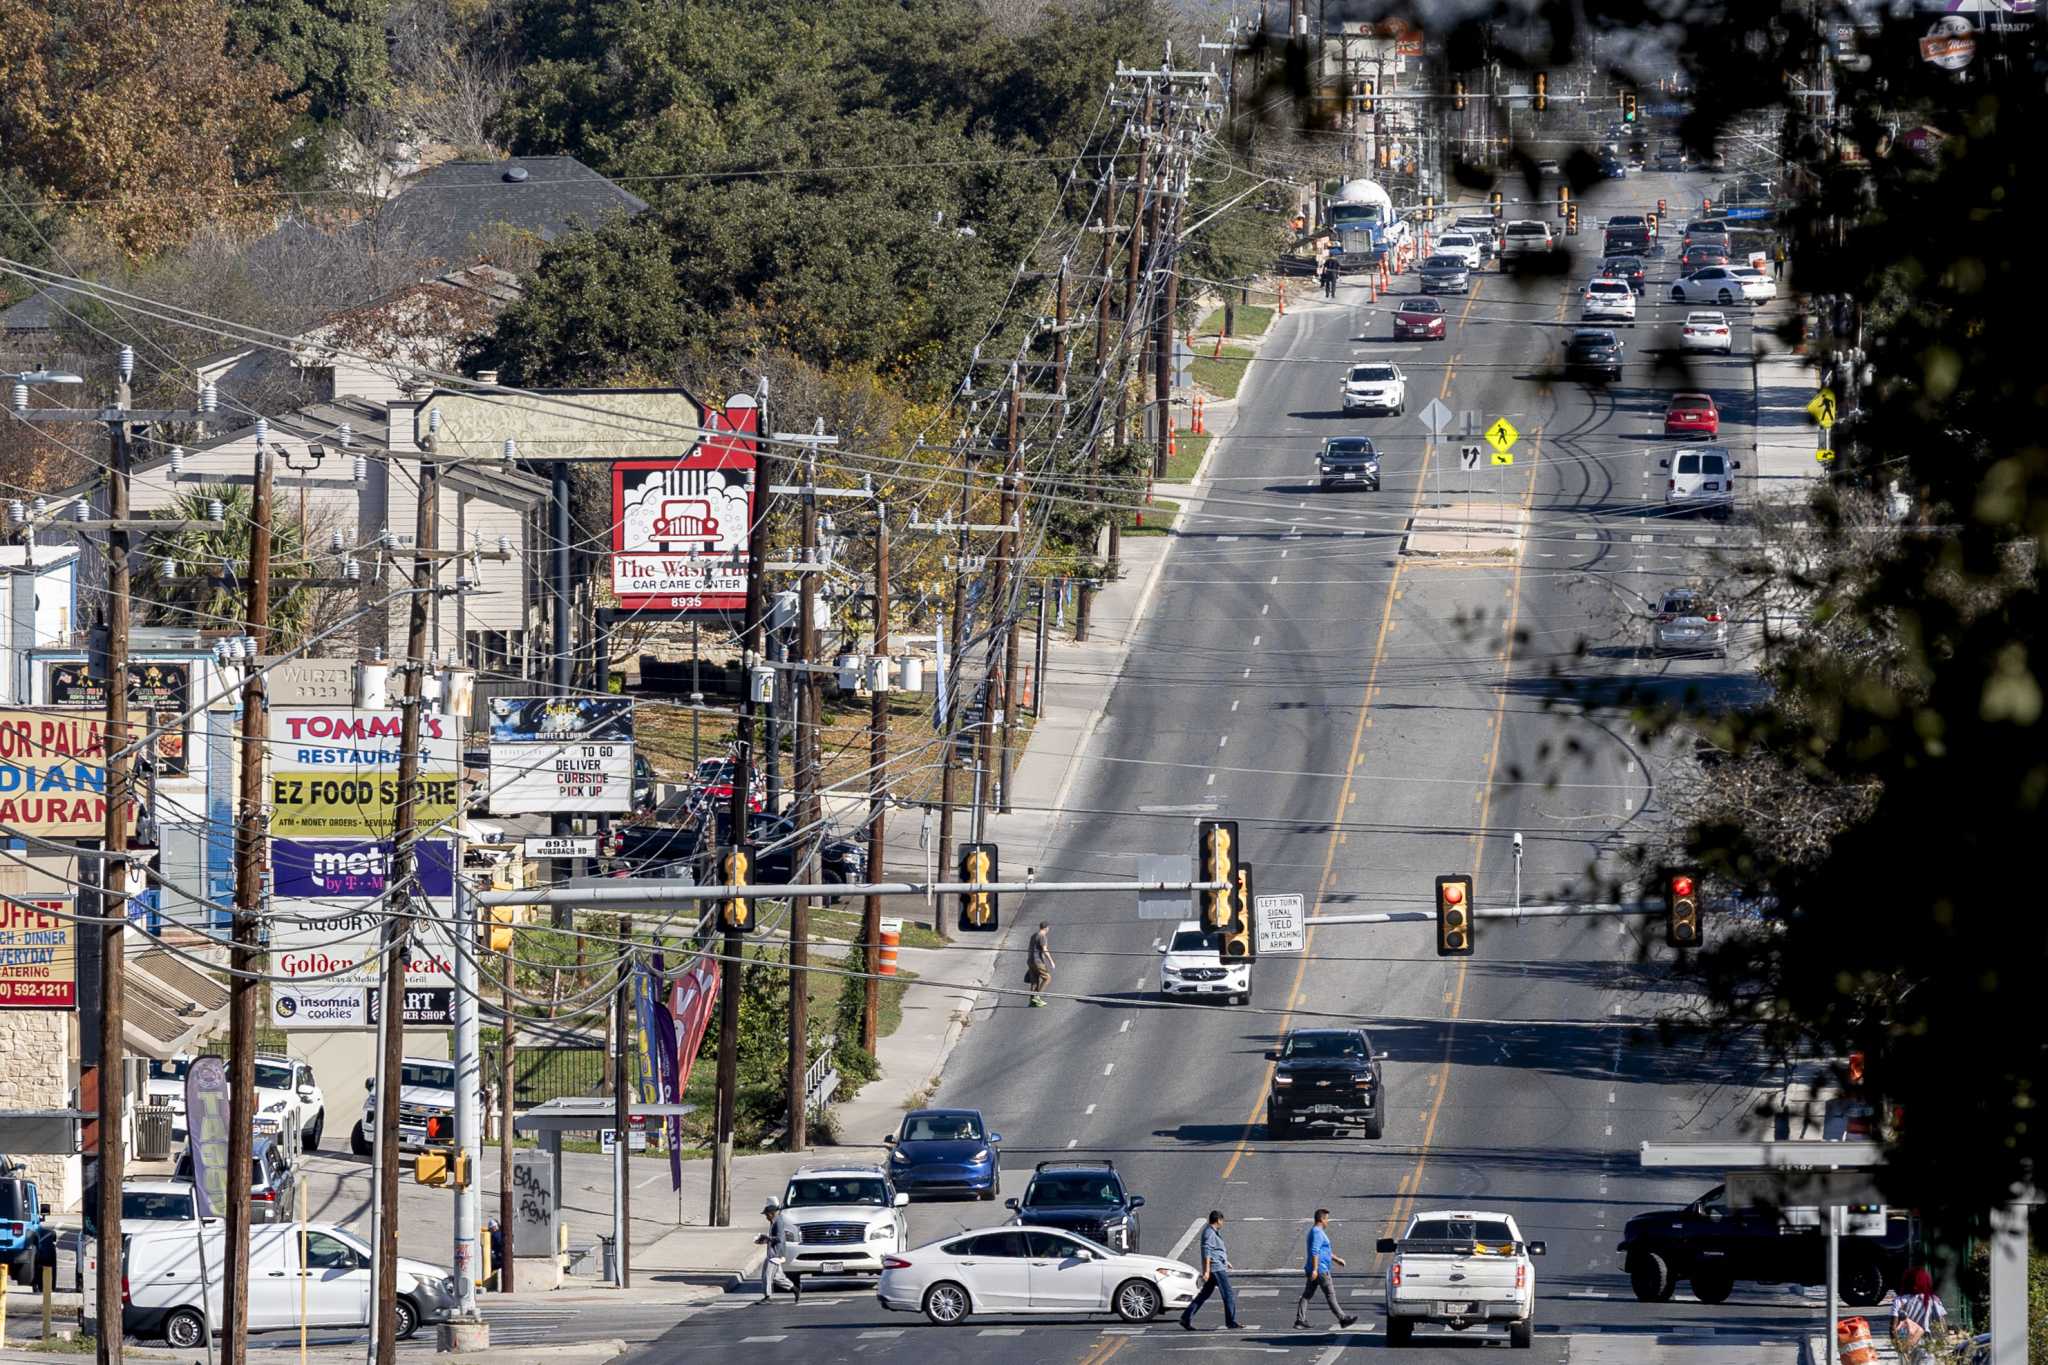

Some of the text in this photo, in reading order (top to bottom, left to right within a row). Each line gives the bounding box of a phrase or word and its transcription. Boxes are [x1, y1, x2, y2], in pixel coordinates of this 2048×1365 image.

[617, 559, 655, 578] The
[632, 580, 656, 589] CAR
[659, 580, 691, 589] CARE
[671, 597, 702, 607] 8935
[286, 714, 443, 740] TOMM'S
[298, 748, 431, 764] RESTAURAT
[582, 746, 613, 758] TO GO
[555, 760, 601, 771] DELIVER
[557, 773, 609, 784] CURBSIDE
[274, 781, 303, 804] EZ
[311, 781, 374, 804] FOOD
[559, 785, 603, 797] PICK UP
[278, 818, 295, 826] ATM
[301, 818, 327, 826] MONEY
[329, 818, 358, 826] ORDERS
[545, 840, 575, 848] 8931
[326, 876, 341, 893] by
[1261, 899, 1276, 907] LEFT
[1270, 919, 1292, 929] YIELD
[24, 931, 66, 945] DINNER
[1260, 930, 1301, 940] ON FLASHING
[1271, 940, 1292, 948] ARROW
[280, 953, 353, 977] Golden
[0, 965, 50, 978] ATERING
[15, 983, 68, 997] 592-1211
[300, 996, 361, 1008] insomnia
[307, 1007, 352, 1019] cookies
[420, 1010, 446, 1021] SHOP
